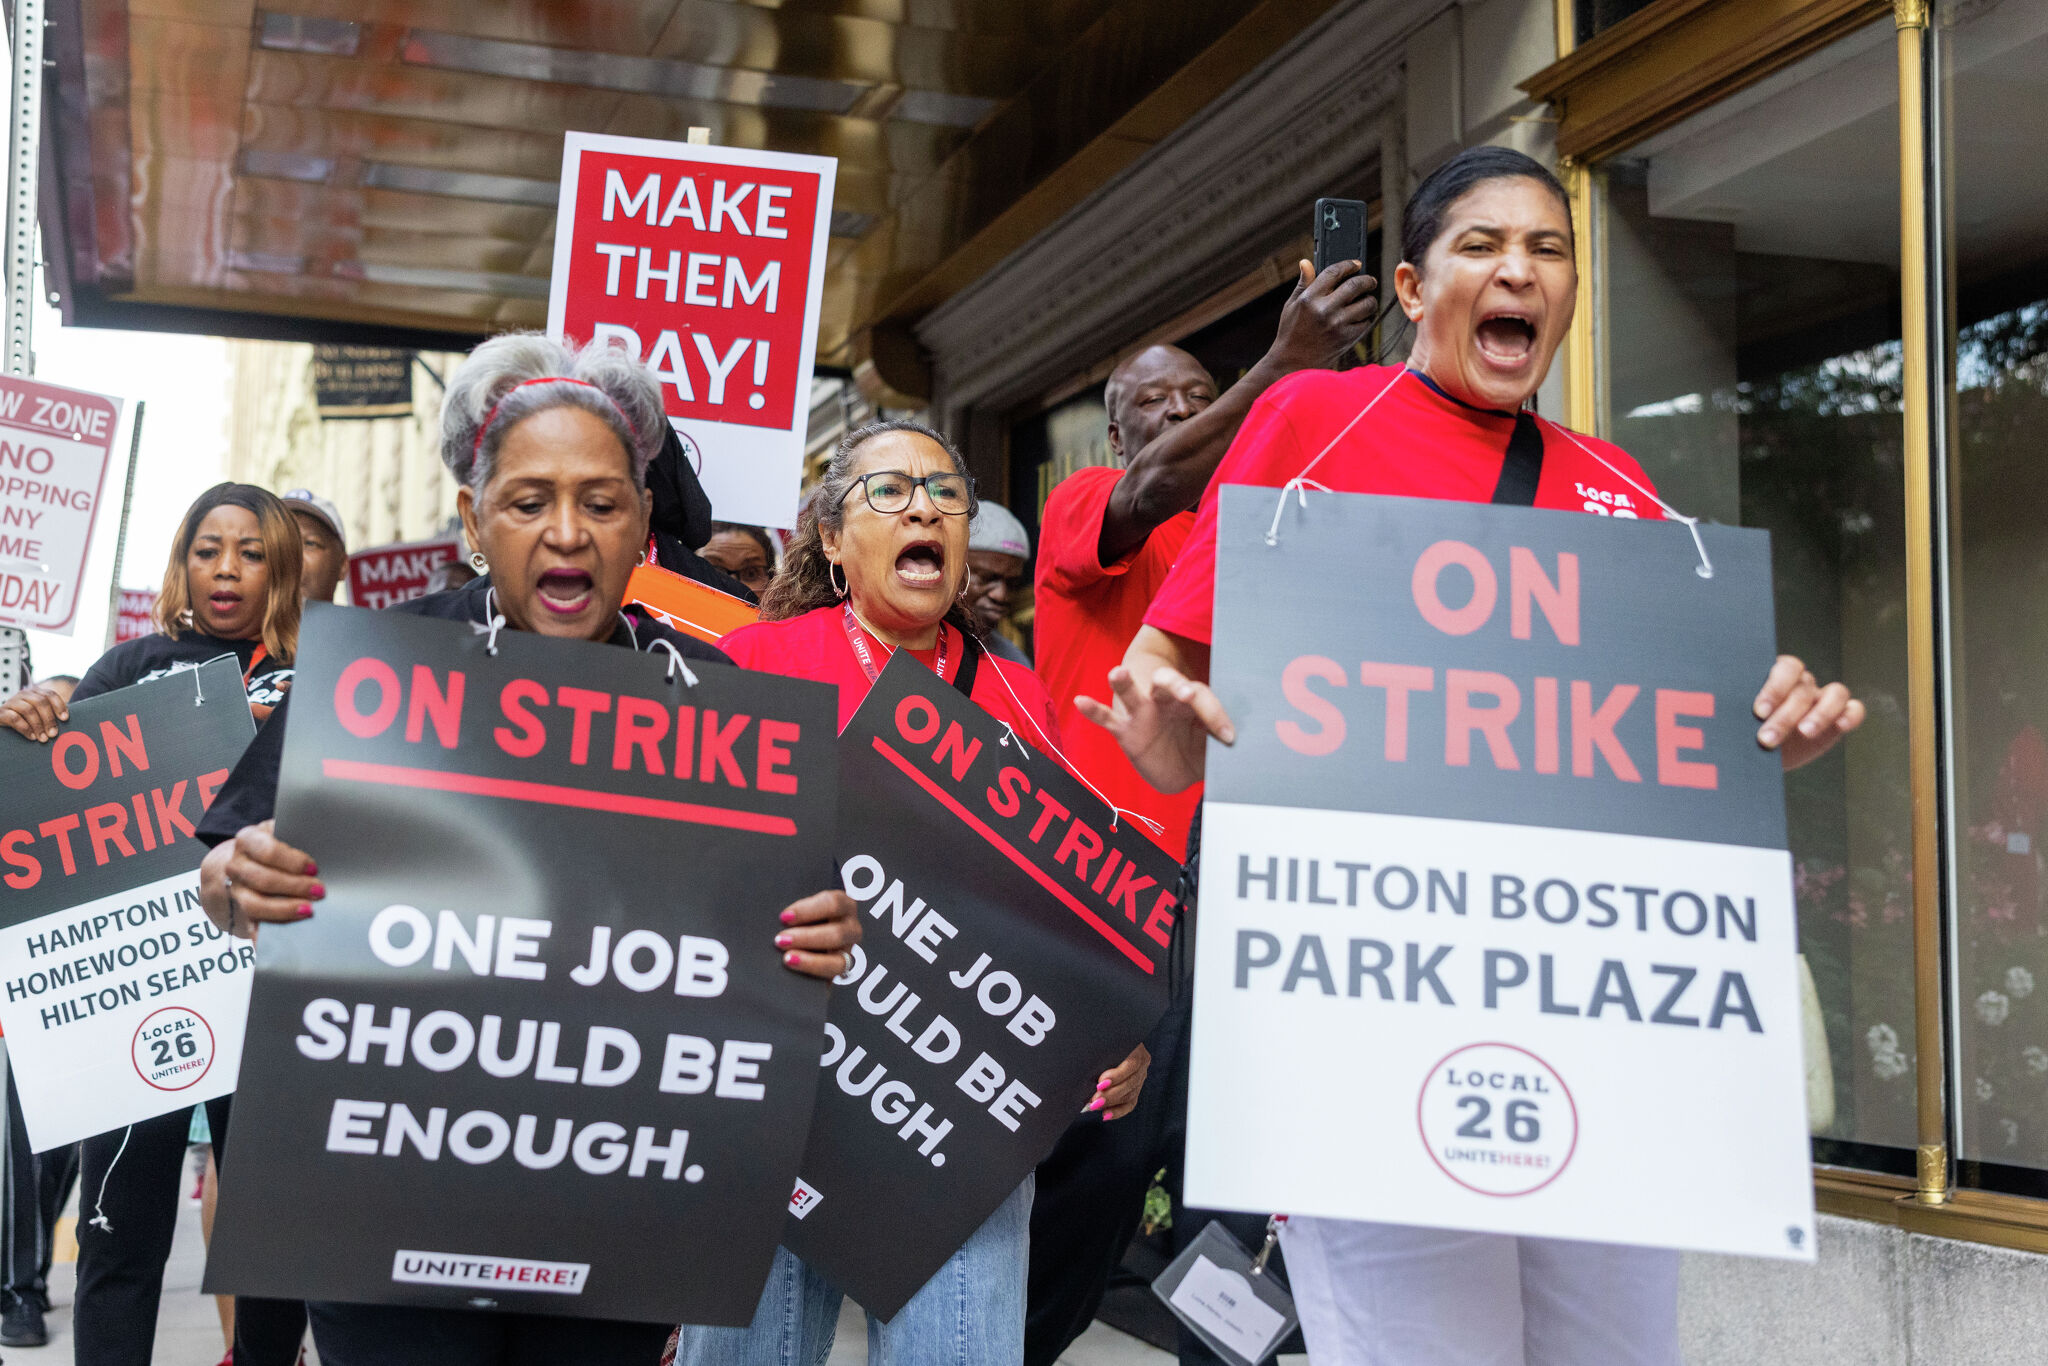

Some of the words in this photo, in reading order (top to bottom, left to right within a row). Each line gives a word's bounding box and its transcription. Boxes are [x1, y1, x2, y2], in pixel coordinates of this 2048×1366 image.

[601, 169, 793, 240] MAKE
[595, 242, 782, 314] THEM
[30, 396, 111, 439] ZONE
[0, 440, 54, 475] NO
[0, 475, 92, 512] PPING
[1574, 482, 1636, 509] LOCA
[0, 573, 61, 614] DAY
[1411, 539, 1581, 646] ON
[51, 713, 150, 790] ON
[333, 656, 466, 750] ON
[494, 678, 800, 795] STRIKE
[1275, 654, 1718, 790] STRIKE
[894, 694, 983, 783] ON
[986, 765, 1188, 949] STRIKE
[26, 896, 169, 959] HAMPTON
[1236, 853, 1468, 917] HILTON
[1491, 873, 1758, 943] BOSTON
[5, 931, 181, 1002] HOMEWOOD
[368, 903, 553, 982] ONE
[570, 925, 730, 999] JOB
[841, 854, 959, 965] ONE
[949, 952, 1056, 1047] JOB
[1233, 929, 1456, 1007] PARK
[1483, 949, 1765, 1035] PLAZA
[40, 980, 141, 1030] HILTON
[142, 1018, 195, 1041] LOCAL
[151, 1032, 196, 1066] 26
[151, 1057, 206, 1080] UNITEHERE!
[296, 998, 642, 1087] SHOULD
[659, 1033, 773, 1100] BE
[1447, 1068, 1549, 1093] LOCAL
[955, 1051, 1042, 1133] BE
[1456, 1094, 1540, 1143] 26
[326, 1099, 705, 1183] ENOUGH.
[1444, 1147, 1552, 1168] UNITEHERE!
[404, 1258, 580, 1286] UNITEHERE!
